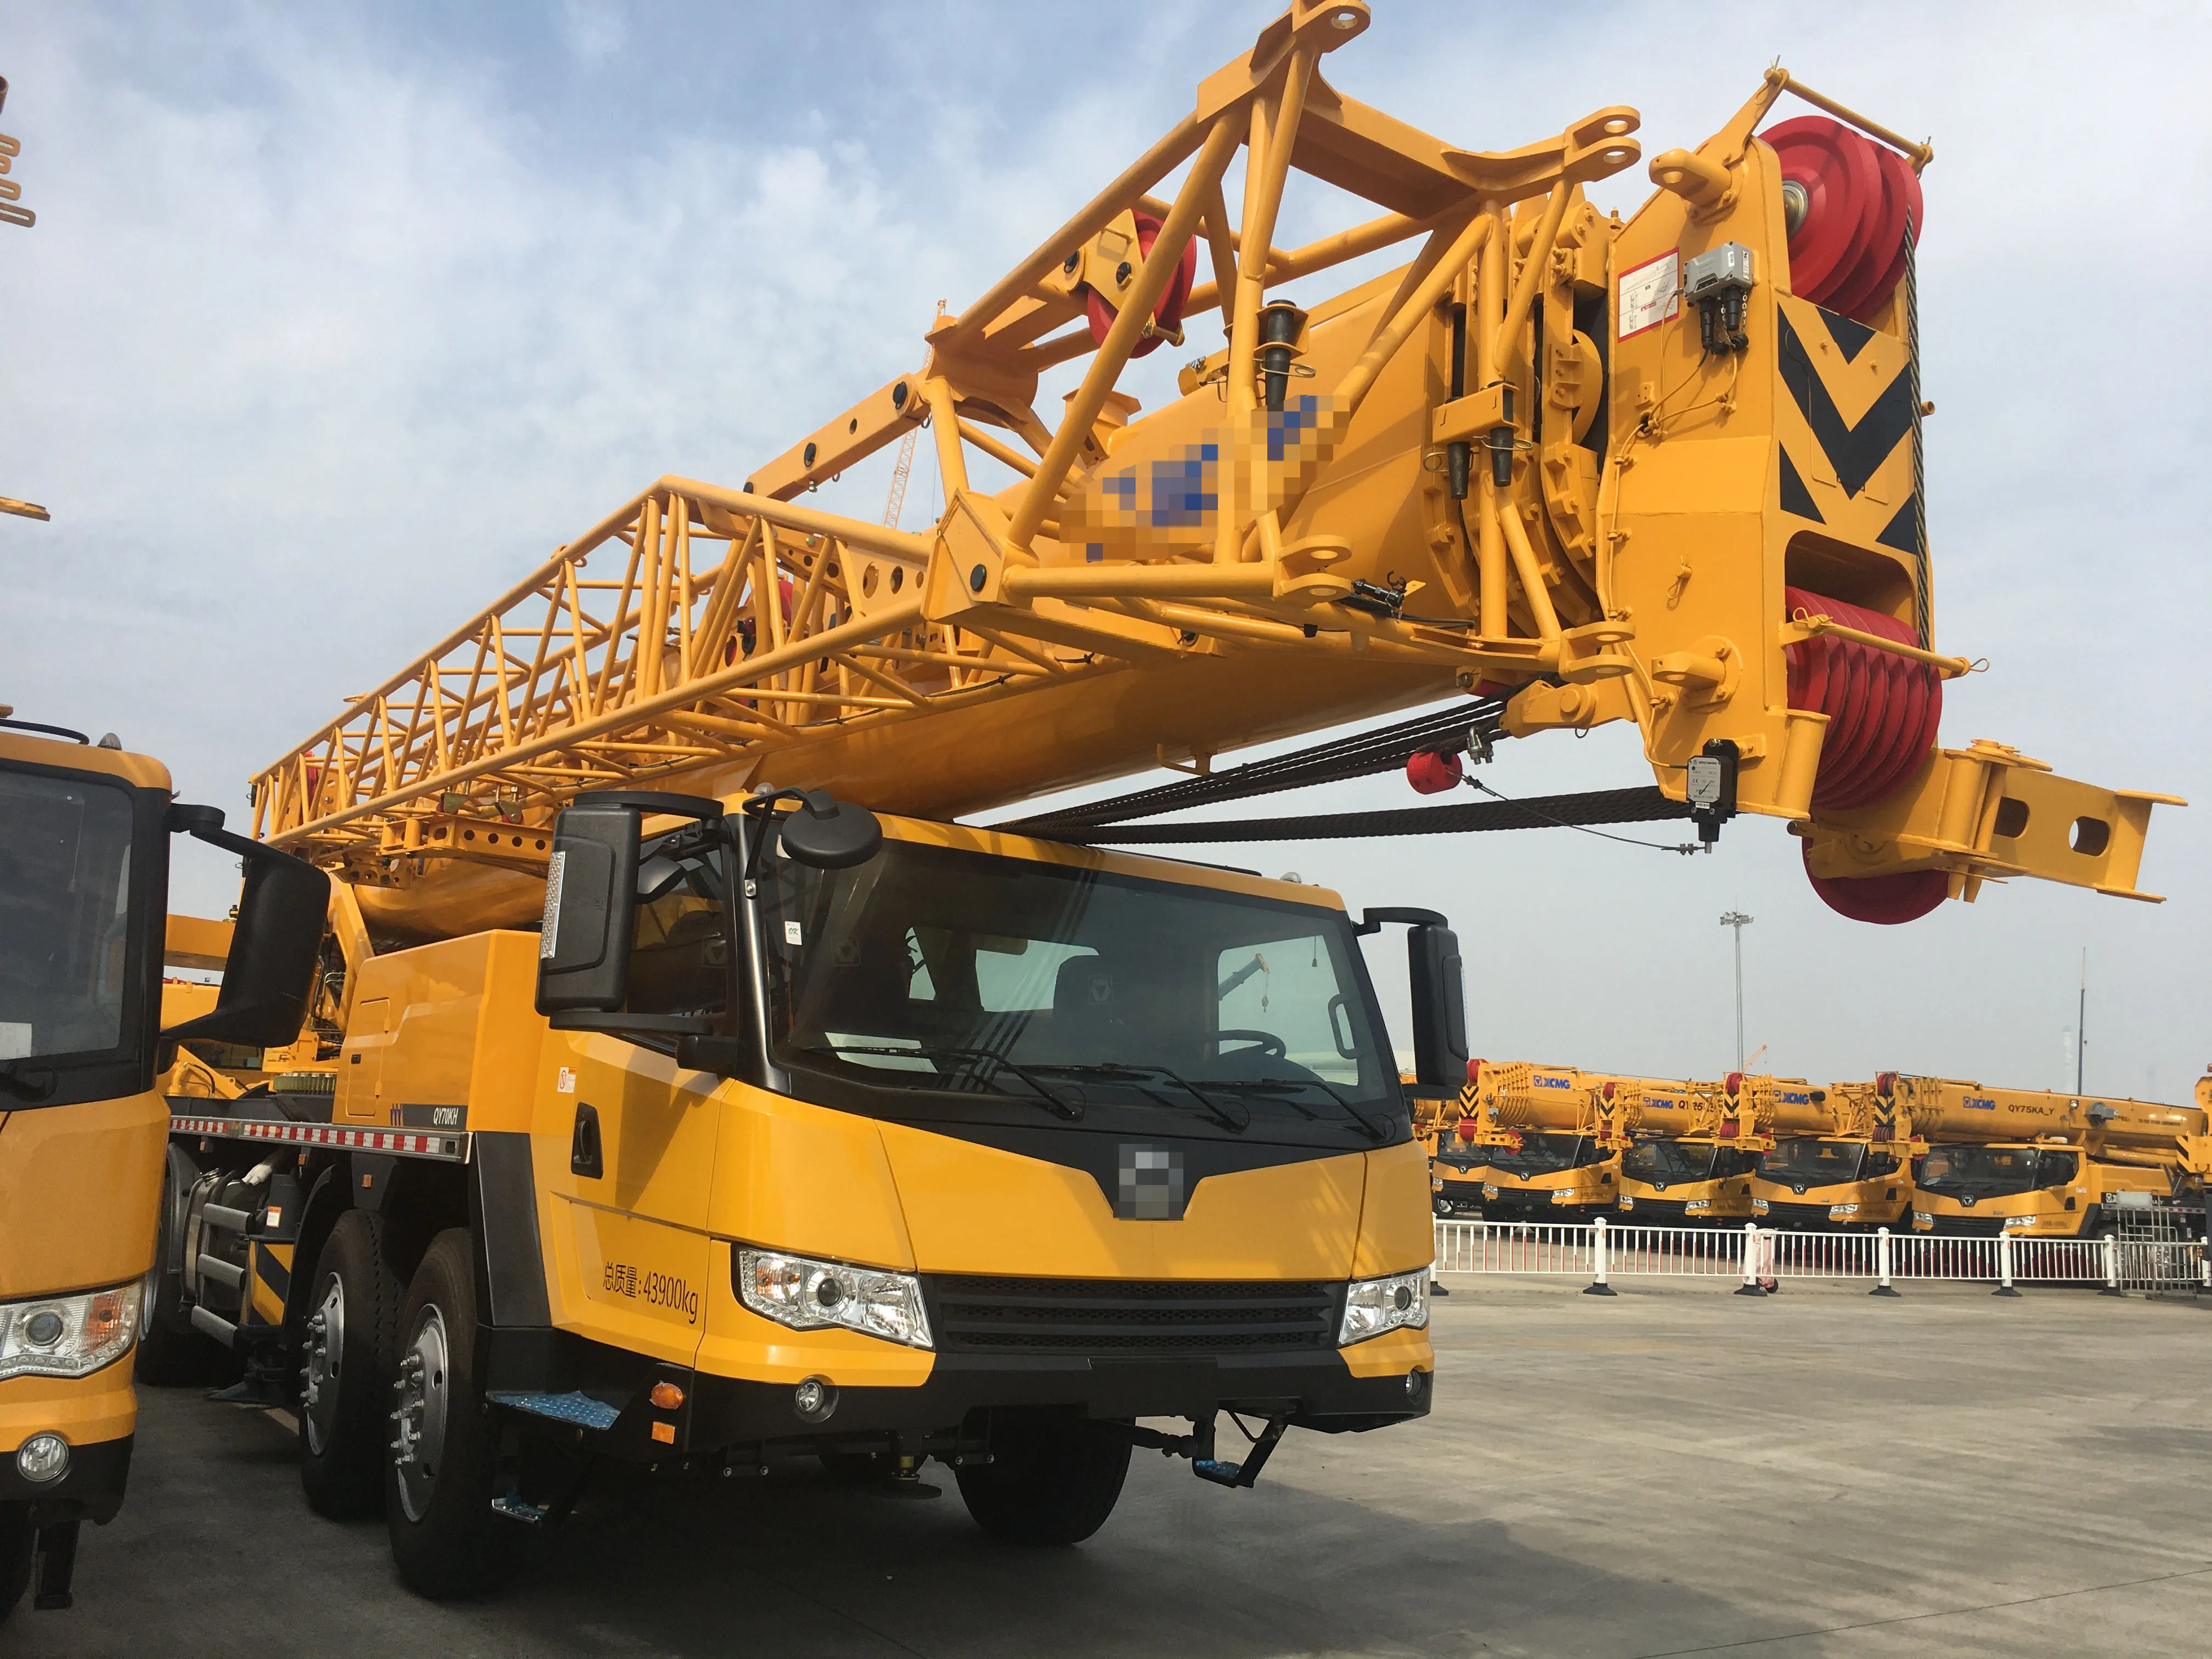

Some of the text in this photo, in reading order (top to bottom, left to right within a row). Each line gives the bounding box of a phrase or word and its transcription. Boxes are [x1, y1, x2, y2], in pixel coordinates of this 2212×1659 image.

[788, 927, 799, 935] OK
[1544, 1077, 1570, 1089] XCMG
[1651, 1099, 1673, 1109] XCMG
[1782, 1092, 1809, 1105] XCMG
[1971, 1098, 2055, 1116] XCMG QY75KA_Y
[433, 1107, 459, 1126] QY70KH
